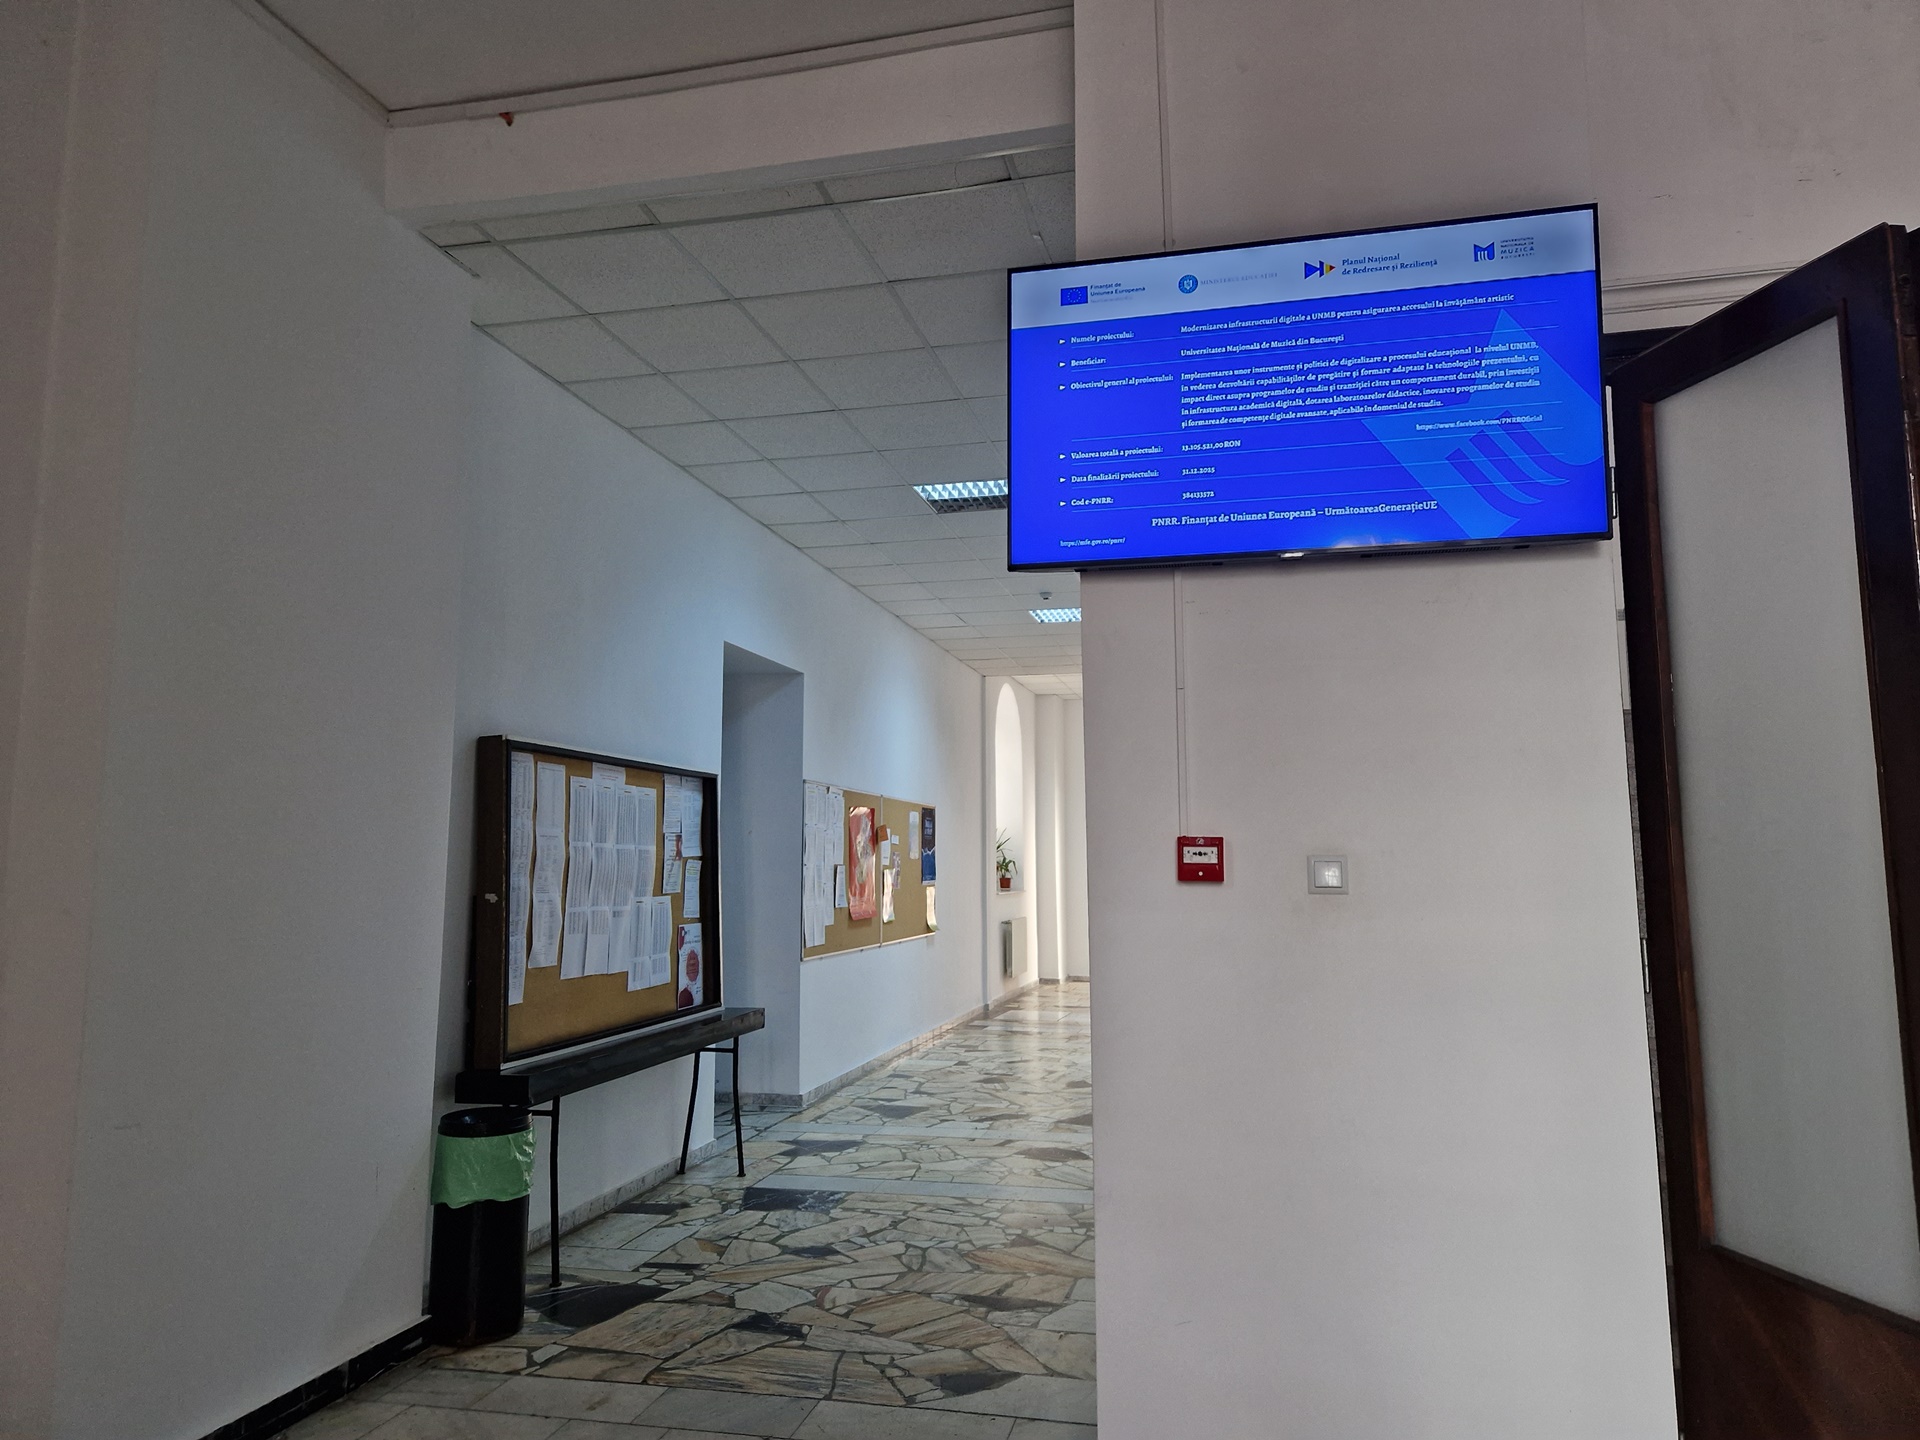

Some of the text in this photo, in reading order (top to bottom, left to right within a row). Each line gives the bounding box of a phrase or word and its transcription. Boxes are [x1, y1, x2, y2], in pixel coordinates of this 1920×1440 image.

[1342, 252, 1400, 266] Planul Național
[1352, 265, 1390, 274] Redresare
[1399, 259, 1437, 269] Reziliență
[1180, 323, 1227, 332] Modernizarea
[1228, 316, 1278, 328] infrastructurii
[1278, 313, 1305, 324] digitale
[1311, 311, 1336, 319] UNMB
[1336, 309, 1361, 319] pentru
[1362, 305, 1400, 315] asigurarea
[1401, 300, 1435, 311] accesului
[1487, 293, 1514, 302] artistic
[1070, 334, 1096, 343] Numele
[1180, 346, 1226, 356] Universitatea
[1270, 338, 1296, 347] Muzică
[1296, 337, 1308, 345] din
[1180, 369, 1233, 380] Implementarea
[1252, 364, 1295, 373] instrumente
[1296, 362, 1302, 371] și
[1303, 359, 1329, 370] politici
[1329, 358, 1339, 366] de
[1339, 356, 1381, 366] digitalizare
[1388, 350, 1426, 362] procesului
[1474, 345, 1482, 353] la
[1483, 343, 1509, 352] nivelul
[1510, 341, 1539, 350] UNMB,
[1189, 382, 1216, 391] vederea
[1217, 378, 1255, 388] dezvoltării
[1317, 370, 1351, 381] pregătire
[1352, 369, 1359, 378] și
[1360, 367, 1391, 376] formare
[1392, 364, 1424, 373] adaptate
[1425, 362, 1433, 370] la
[1434, 358, 1480, 369] tehnologiile
[1481, 354, 1528, 367] prezentului,
[1070, 379, 1103, 389] Obiectivul
[1103, 377, 1128, 388] general
[1181, 395, 1205, 404] impact
[1226, 392, 1250, 400] asupra
[1251, 387, 1295, 399] programelor
[1305, 384, 1328, 393] studiu
[1329, 383, 1336, 392] și
[1371, 379, 1389, 387] către
[1401, 374, 1456, 384] comportament
[1457, 370, 1487, 379] durabil,
[1487, 369, 1505, 379] prin
[1189, 405, 1237, 414] infrastructura
[1238, 401, 1275, 410] academică
[1305, 397, 1333, 405] dotarea
[1333, 391, 1386, 402] laboratoarelor
[1386, 388, 1422, 398] didactice,
[1422, 387, 1455, 395] inovarea
[1455, 381, 1504, 394] programelor
[1504, 380, 1514, 388] de
[1515, 378, 1540, 387] studiu
[1181, 419, 1187, 429] și
[1219, 416, 1228, 424] de
[1269, 411, 1296, 421] digitale
[1328, 405, 1364, 416] aplicabile
[1372, 401, 1407, 411] domeniul
[1417, 399, 1443, 407] studiu.
[1223, 439, 1240, 448] RON
[1070, 451, 1099, 459] Valoarea
[1099, 448, 1119, 457] totală
[1087, 472, 1119, 481] finalizării
[1182, 466, 1215, 475] 31.12.2025
[1070, 497, 1113, 506] Cod e-PNRR:
[1151, 517, 1180, 526] PNRR.
[1181, 515, 1217, 525] Finanțat
[1218, 513, 1229, 522] de
[1230, 512, 1267, 521] Uniunea
[1268, 508, 1316, 520] Europeană
